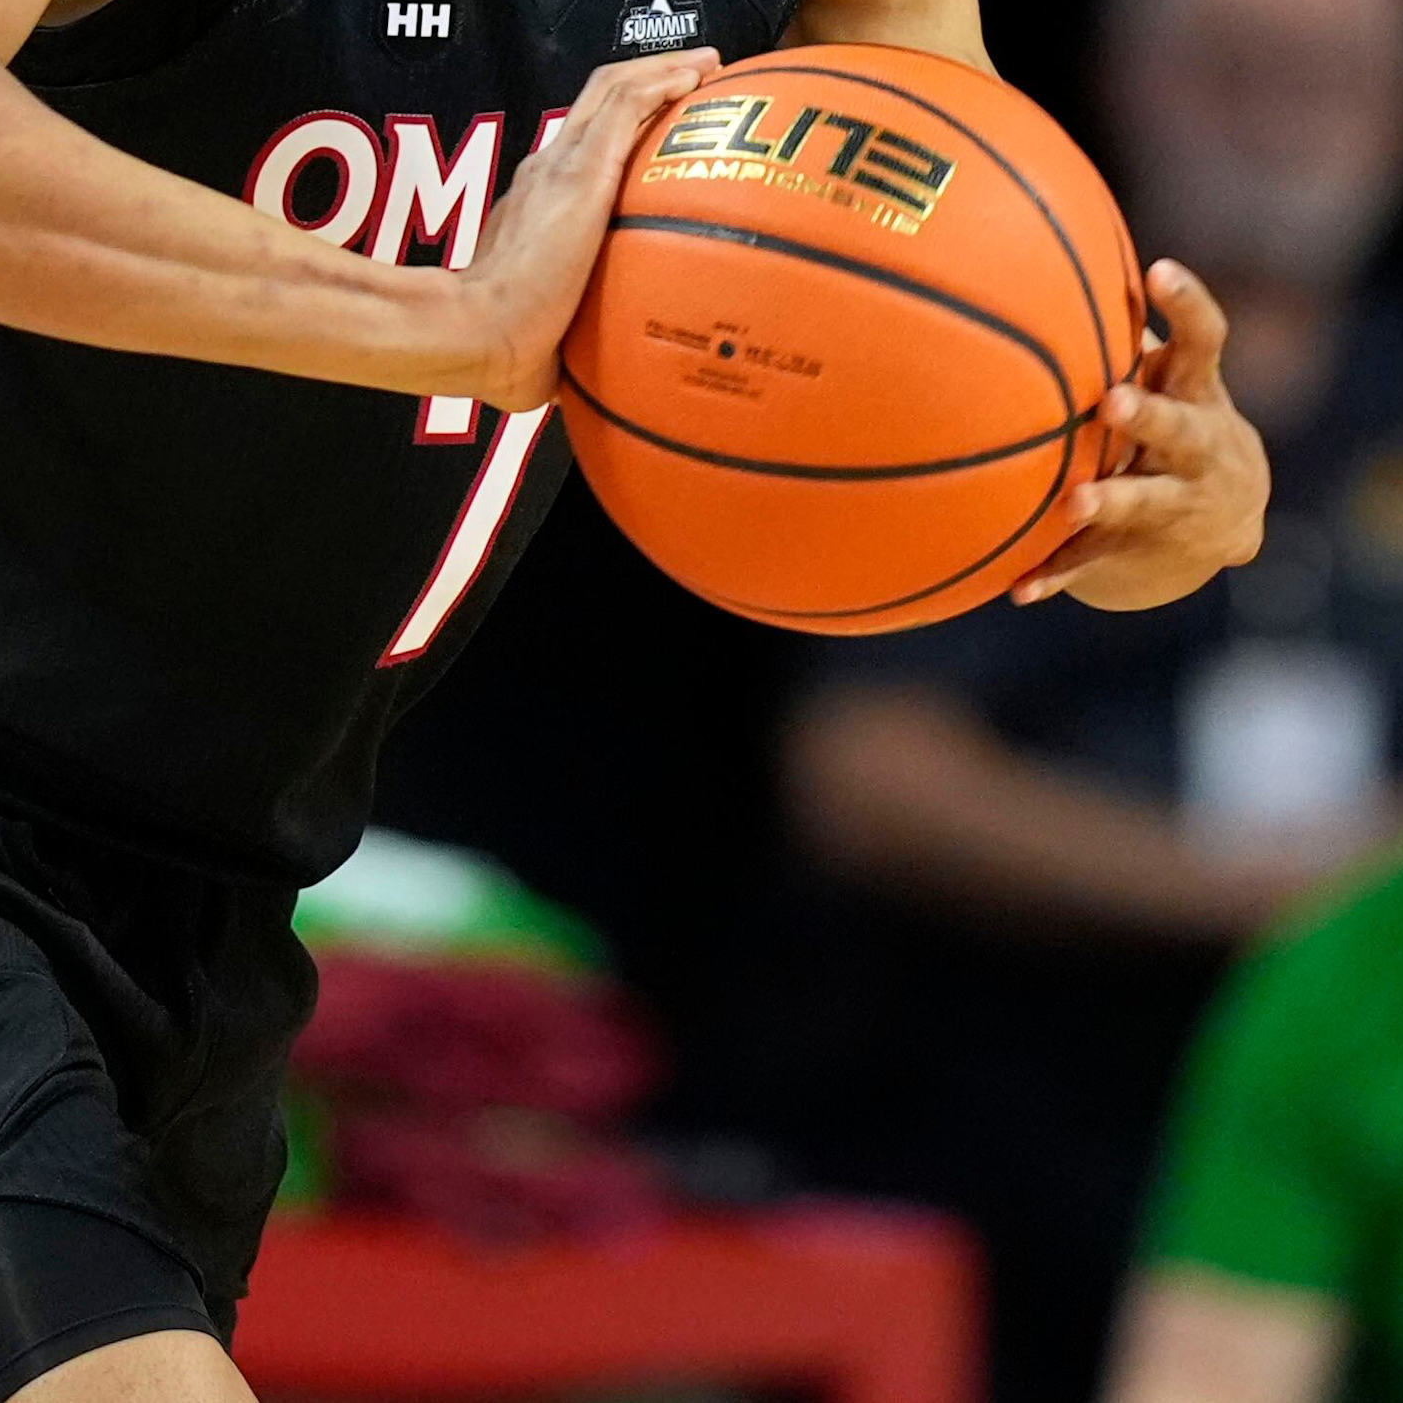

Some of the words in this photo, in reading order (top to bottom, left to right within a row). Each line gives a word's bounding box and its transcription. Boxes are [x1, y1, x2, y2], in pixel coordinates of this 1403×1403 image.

[387, 3, 451, 38] HH
[621, 12, 697, 43] SUMMIT
[640, 38, 682, 52] LEAGUE
[651, 95, 957, 221] ELITE
[242, 109, 570, 270] OM
